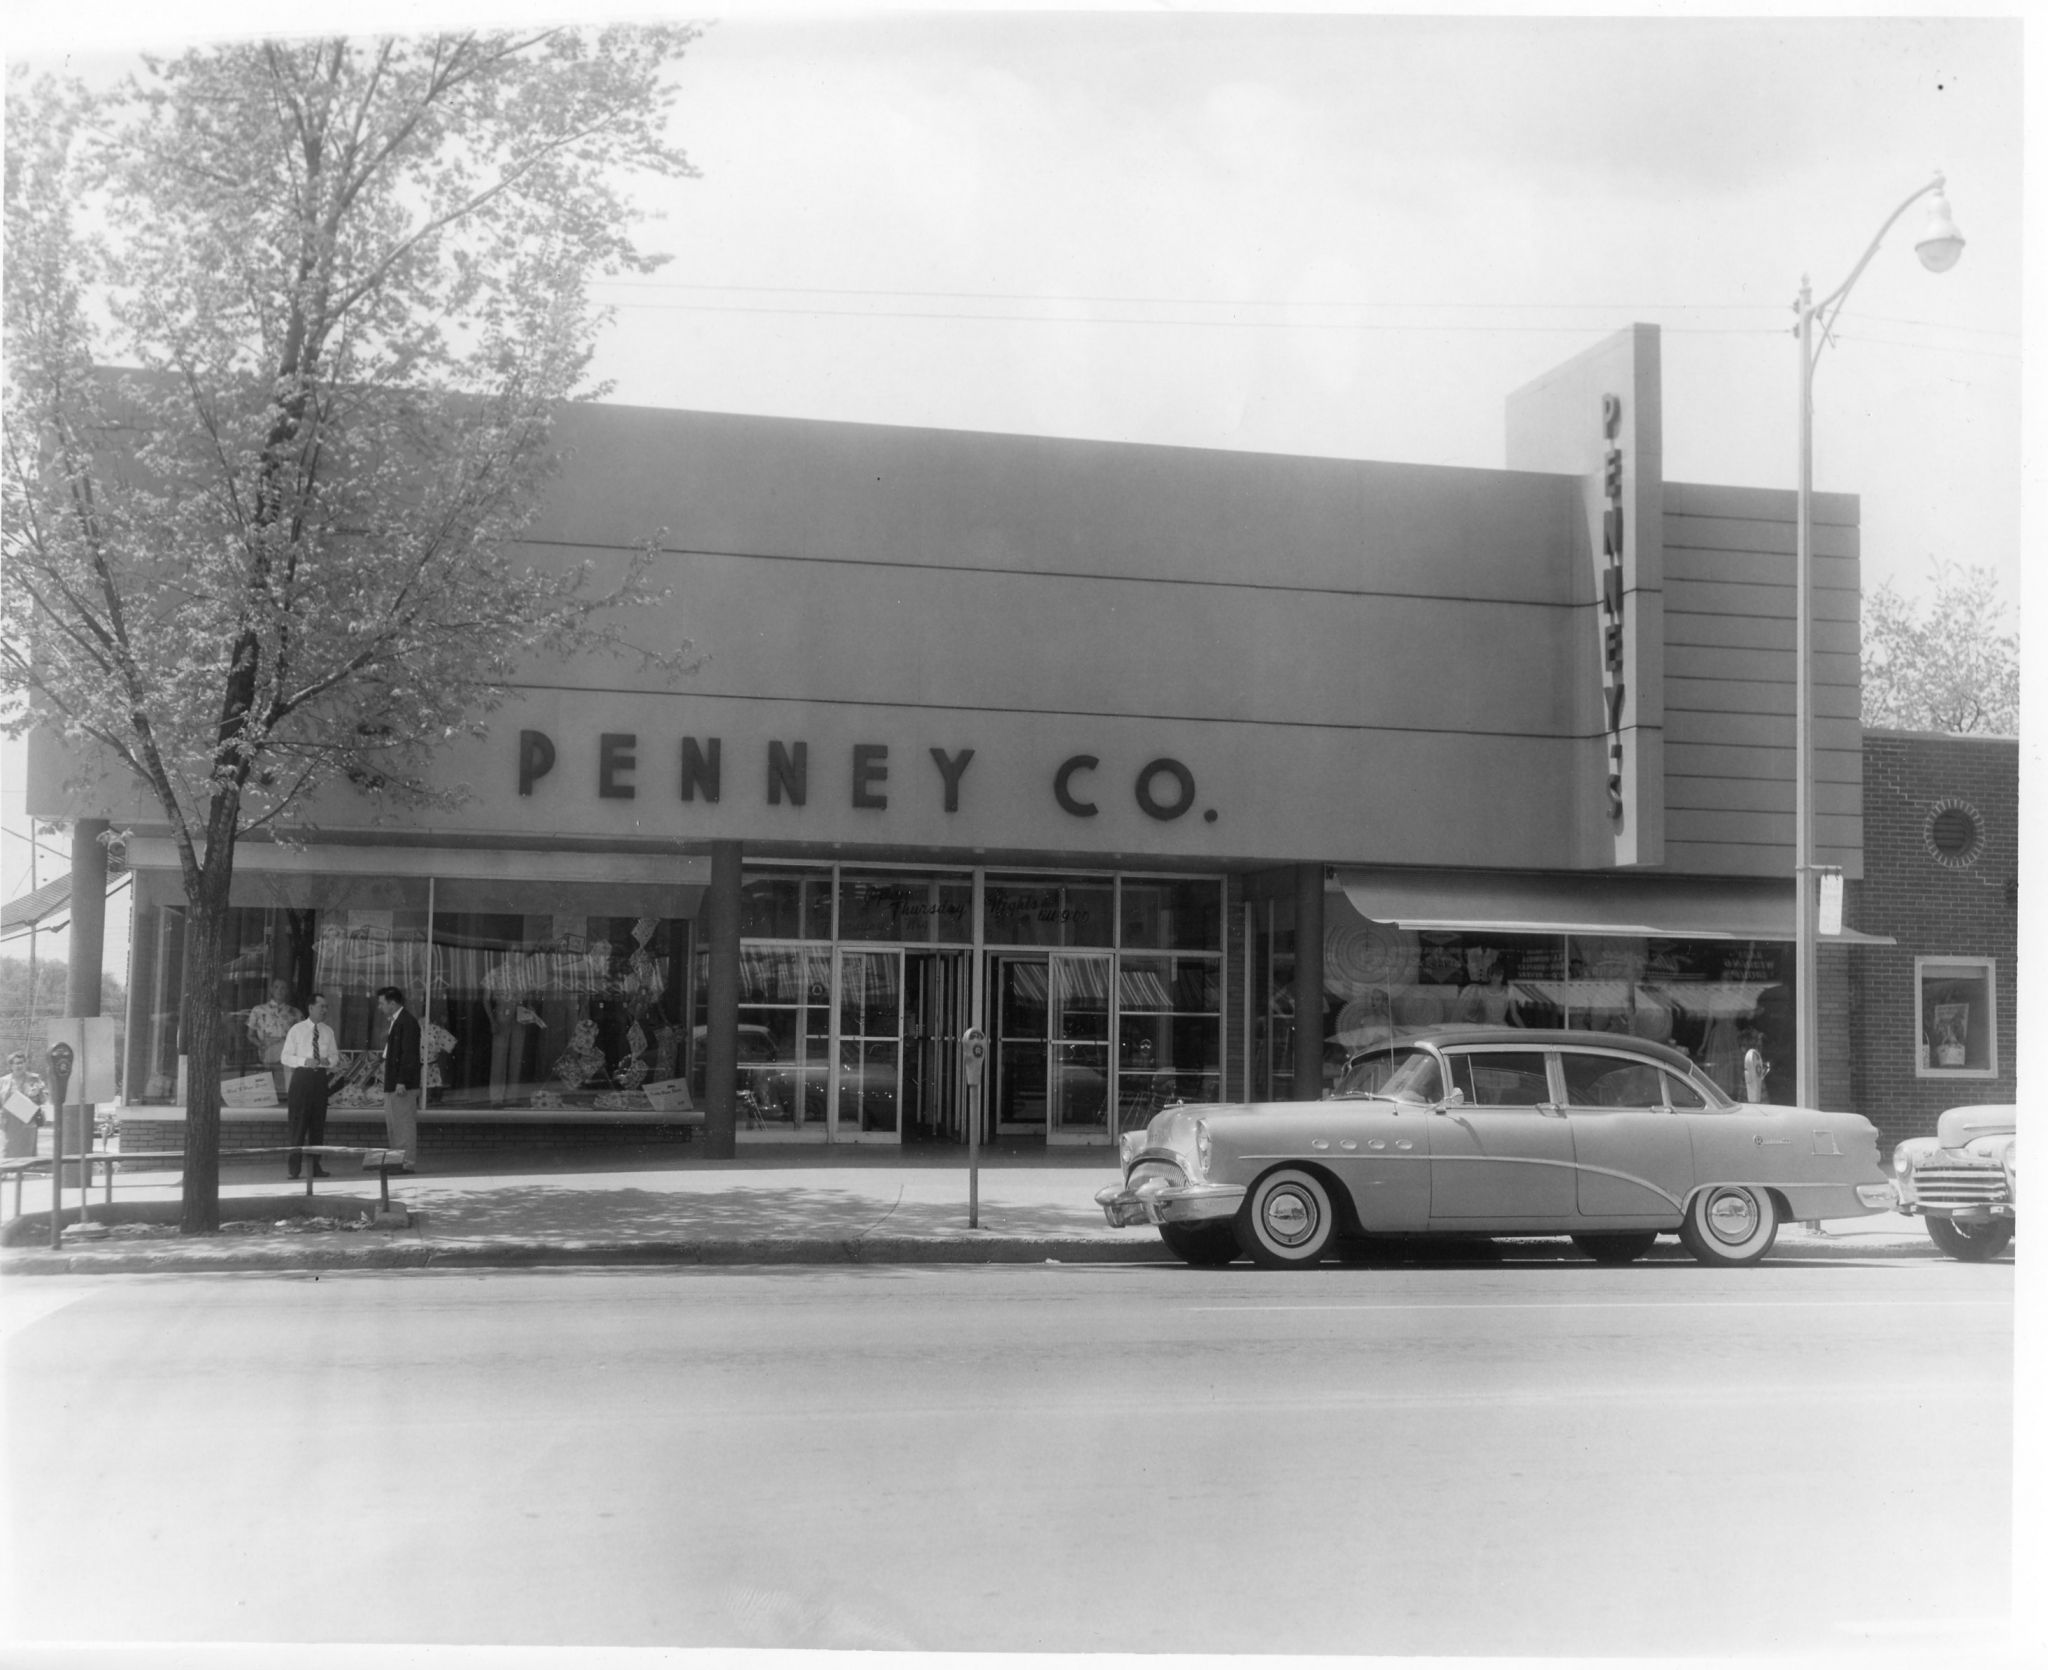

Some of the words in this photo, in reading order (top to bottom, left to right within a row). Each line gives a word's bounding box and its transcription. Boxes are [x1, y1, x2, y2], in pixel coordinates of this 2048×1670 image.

[518, 729, 976, 813] PENNEY
[1054, 754, 1219, 824] CO.
[890, 897, 967, 921] Thursday
